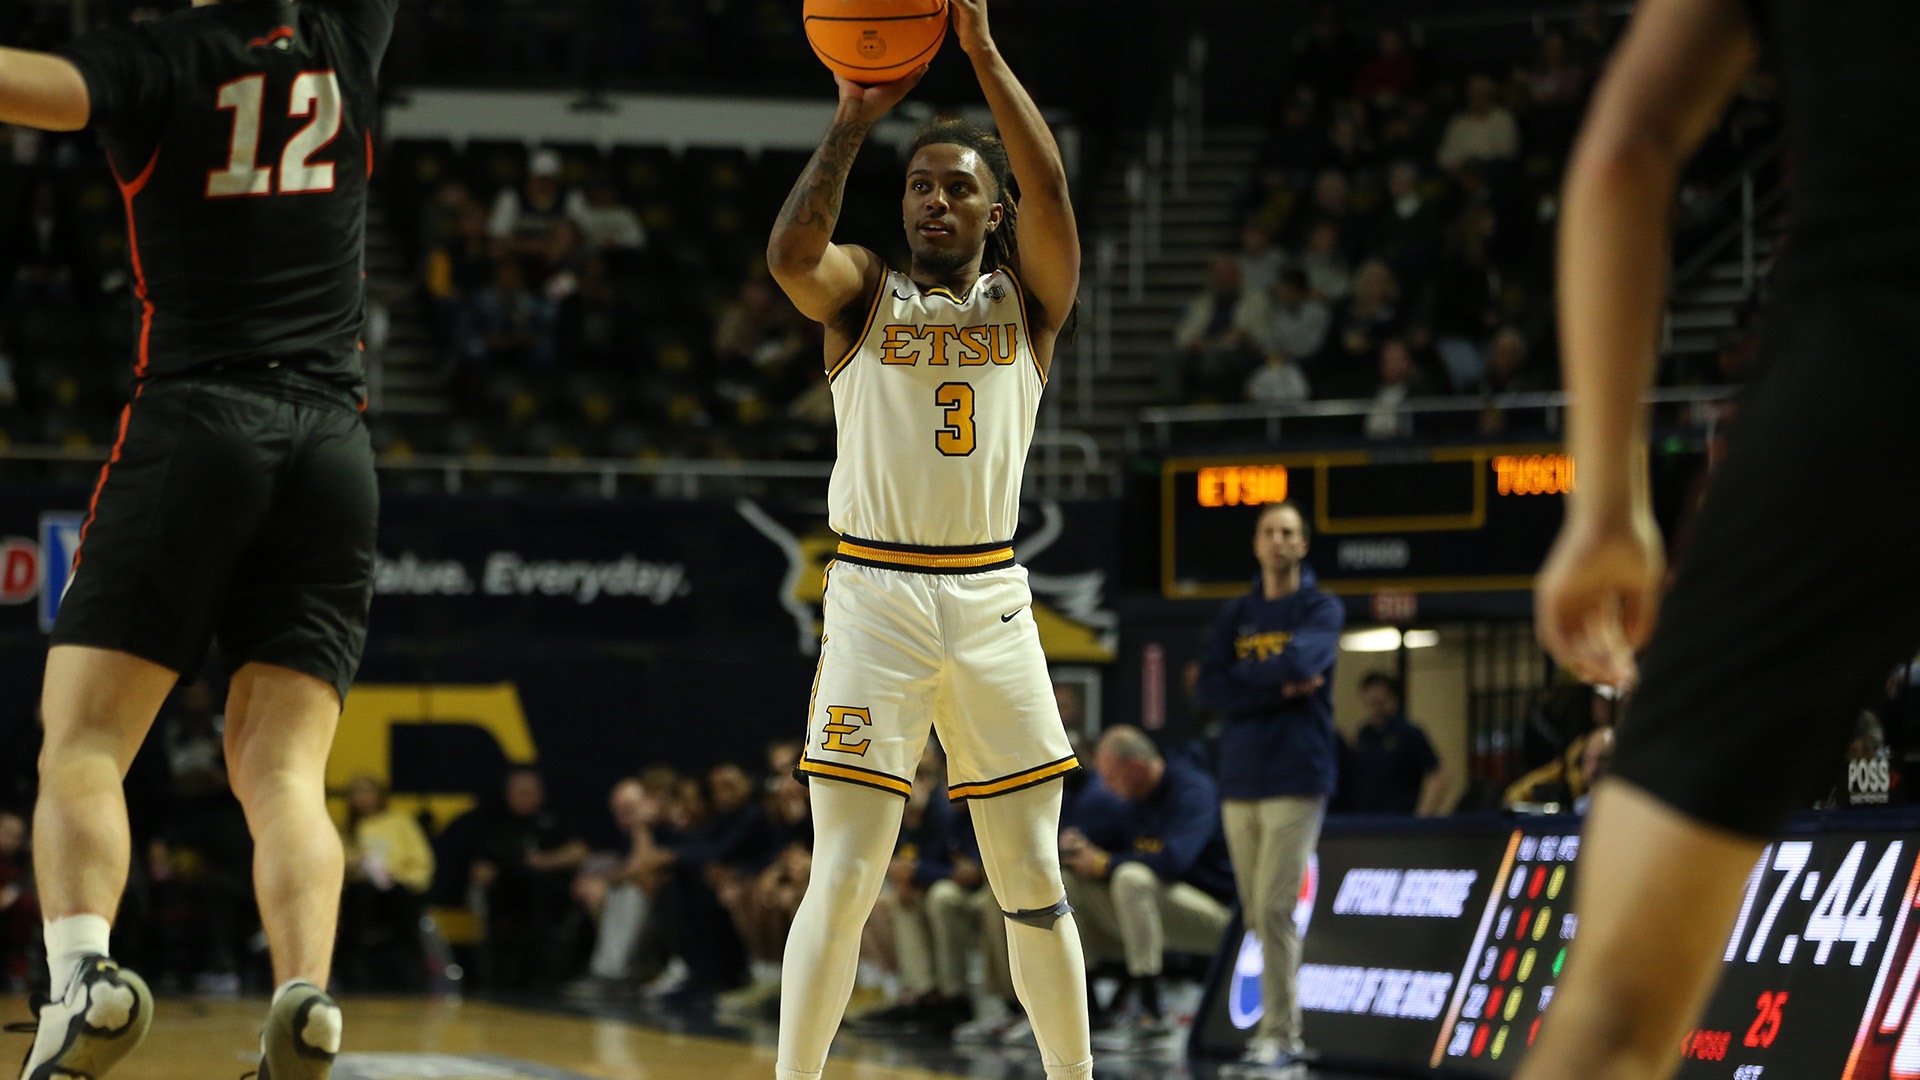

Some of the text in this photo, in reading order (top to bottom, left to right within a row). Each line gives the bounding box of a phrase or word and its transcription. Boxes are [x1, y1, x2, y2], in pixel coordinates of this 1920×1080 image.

[204, 70, 343, 198] 12
[881, 323, 1019, 367] ETSU
[935, 382, 976, 457] 3
[374, 551, 690, 605] alue. Everyday.
[821, 705, 873, 757] E
[1848, 759, 1890, 793] POSS
[1723, 840, 1904, 967] 17:44
[1744, 991, 1789, 1048] 25
